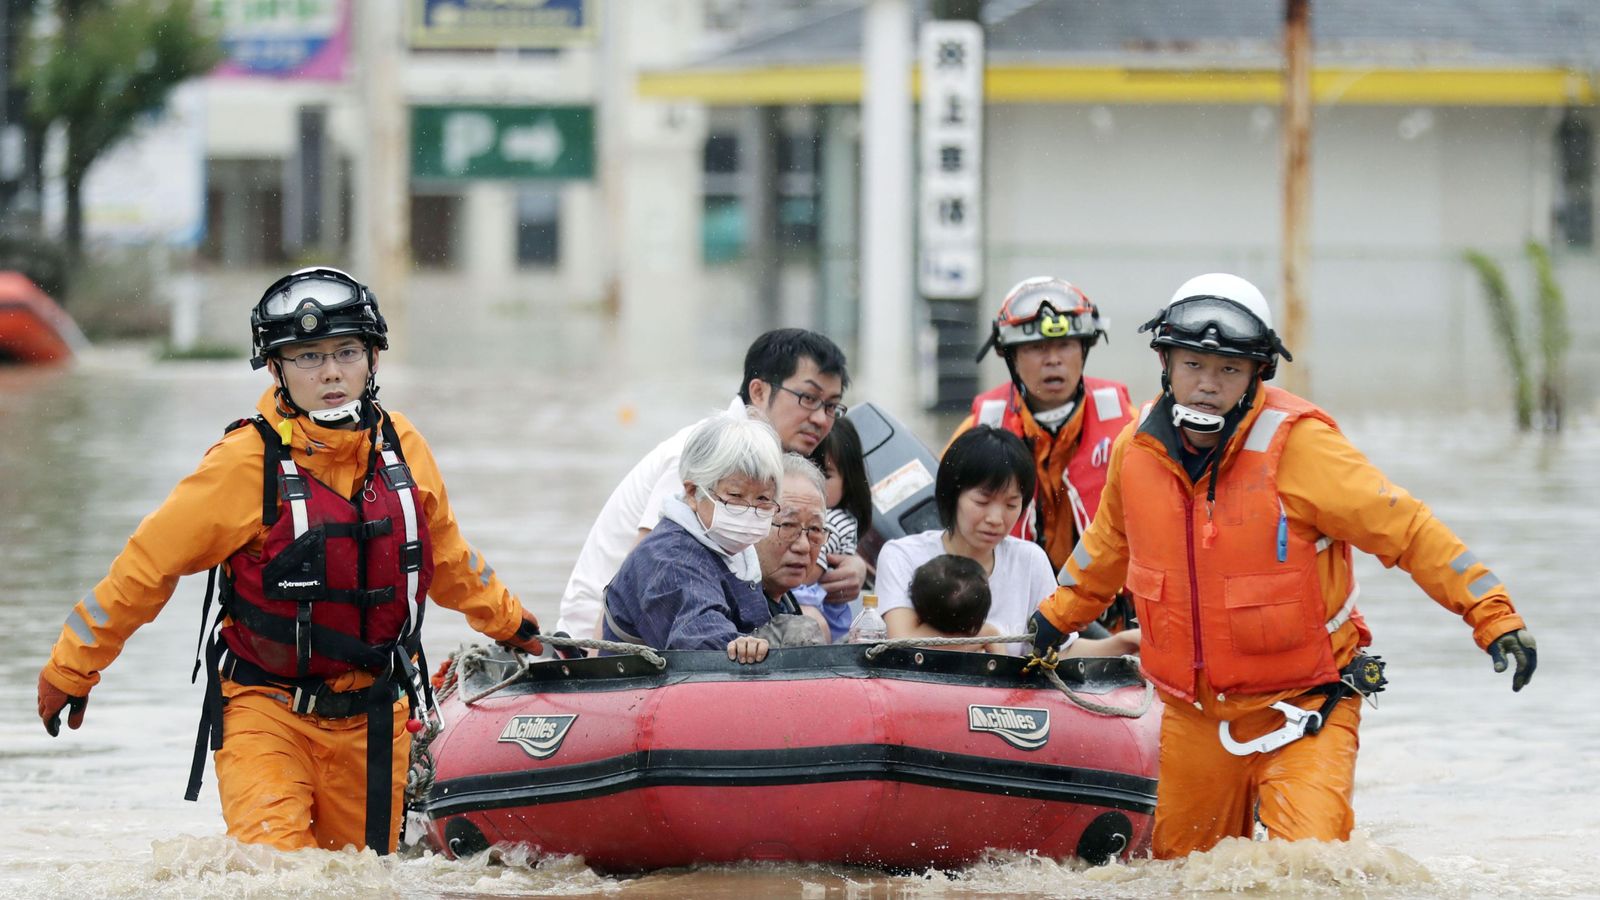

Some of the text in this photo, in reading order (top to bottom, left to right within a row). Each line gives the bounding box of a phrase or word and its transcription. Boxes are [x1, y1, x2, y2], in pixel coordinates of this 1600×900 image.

[442, 112, 496, 175] P
[501, 717, 557, 739] Achilles
[972, 707, 1037, 730] Achilles
